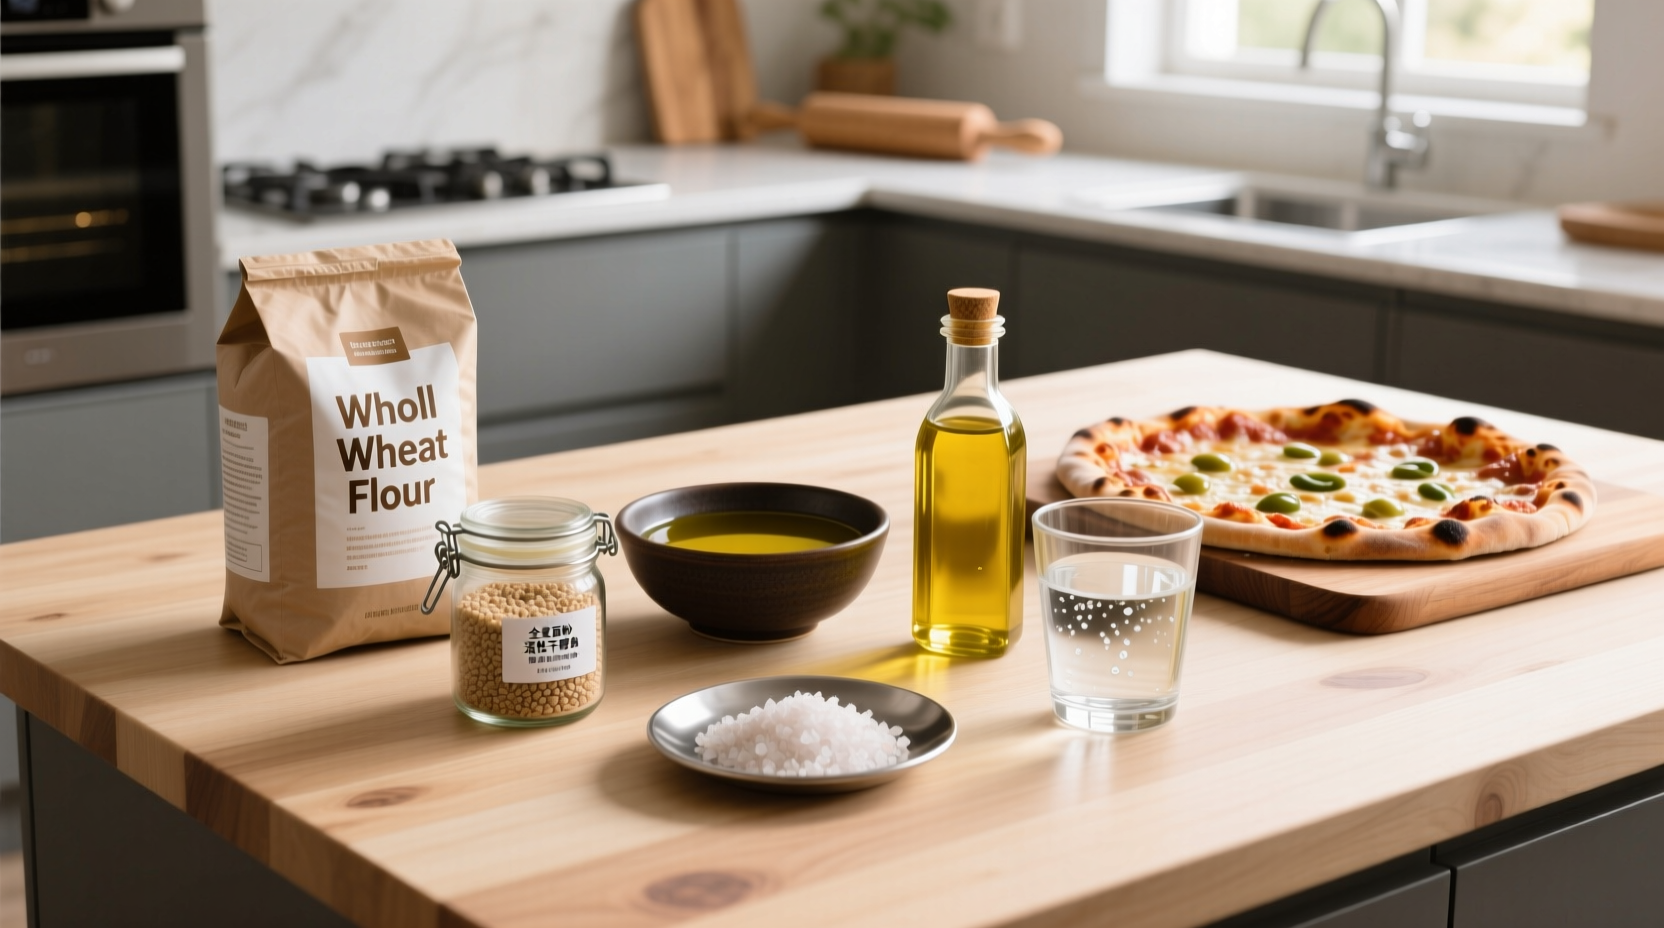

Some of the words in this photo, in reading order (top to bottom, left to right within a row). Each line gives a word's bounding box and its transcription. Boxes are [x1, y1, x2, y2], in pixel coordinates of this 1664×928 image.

[335, 384, 437, 429] Wholl
[336, 429, 449, 473] Wheat
[348, 477, 436, 515] Flour
